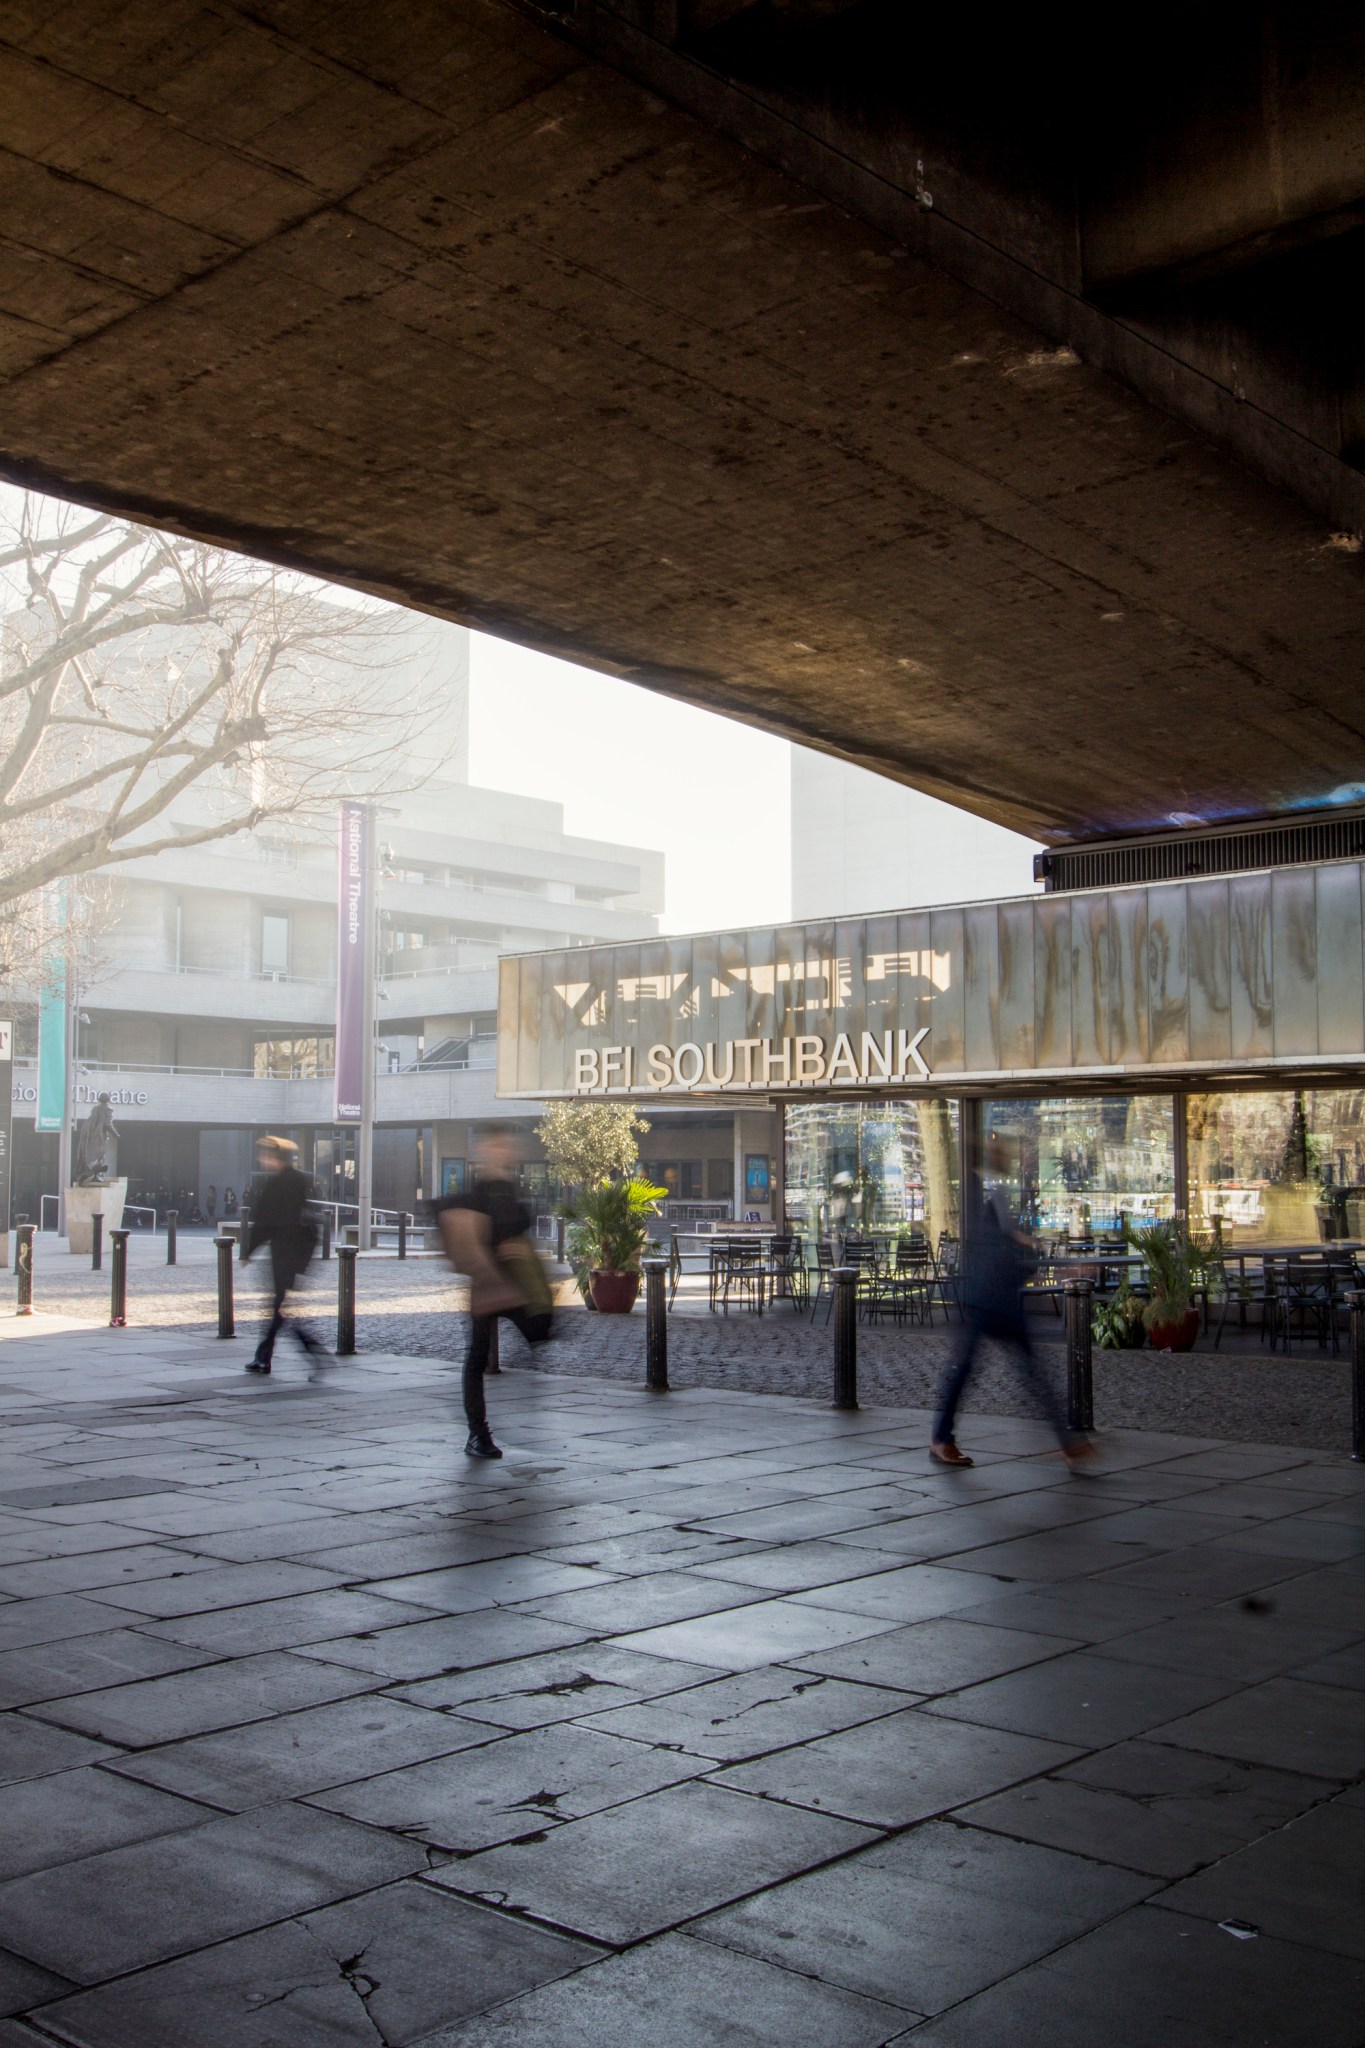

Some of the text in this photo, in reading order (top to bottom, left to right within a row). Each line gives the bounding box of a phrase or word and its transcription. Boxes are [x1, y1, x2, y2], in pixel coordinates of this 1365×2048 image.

[349, 810, 362, 944] National Theatre
[575, 1027, 932, 1089] BFI SOUTHBANK
